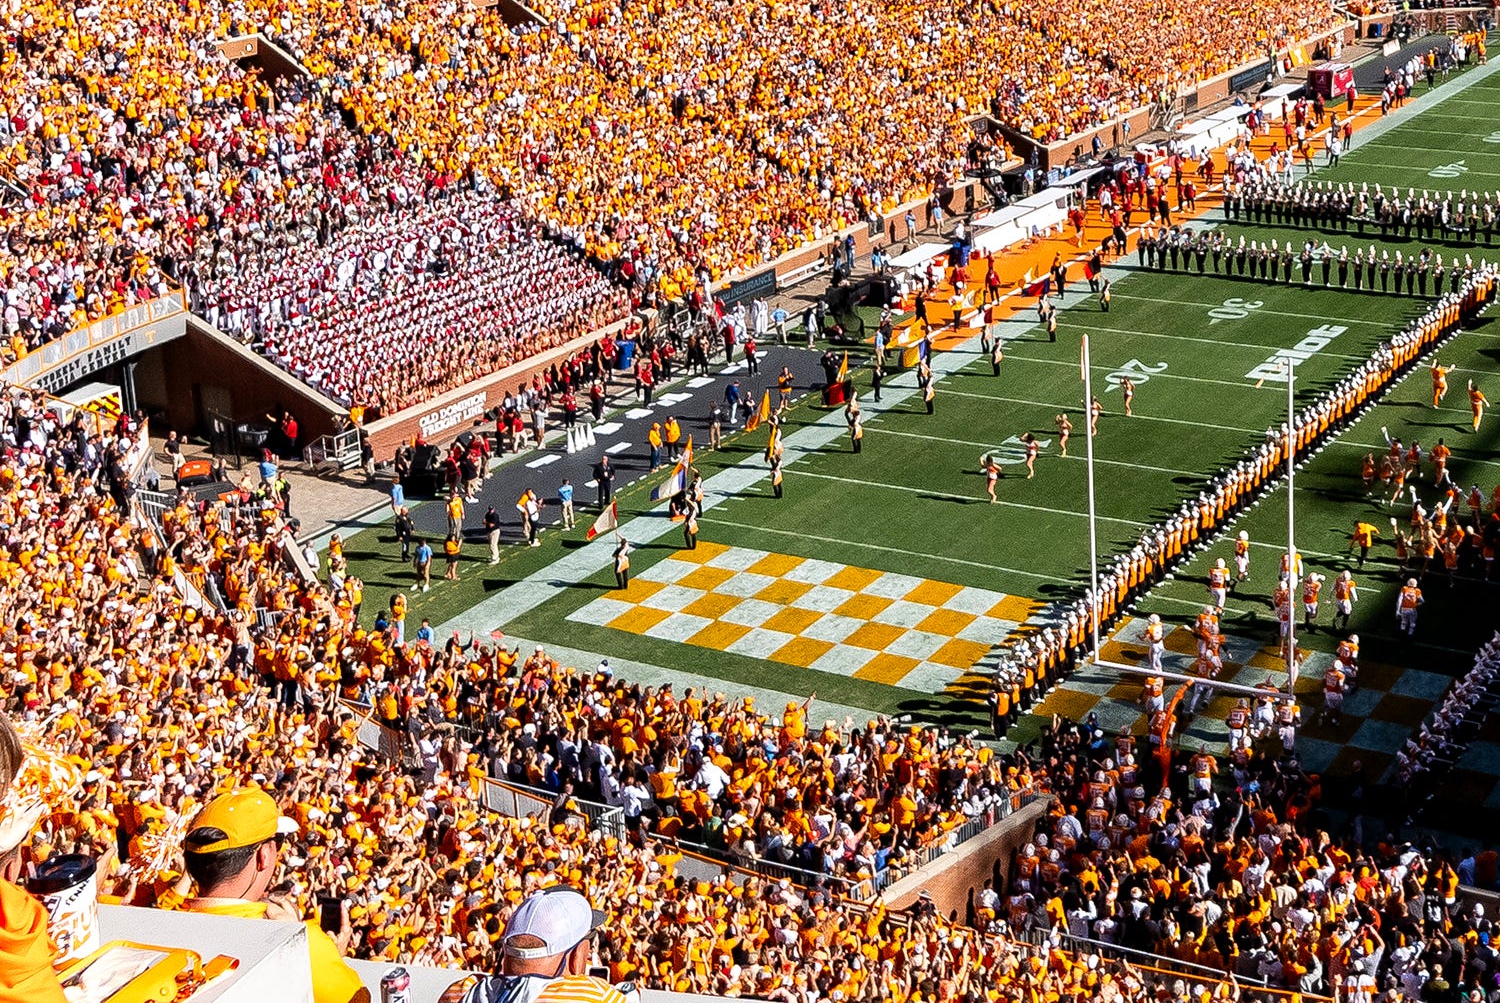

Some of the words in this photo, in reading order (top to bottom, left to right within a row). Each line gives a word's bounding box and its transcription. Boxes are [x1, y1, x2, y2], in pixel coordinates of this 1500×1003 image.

[731, 272, 773, 298] INSURANCE
[1208, 298, 1263, 320] 30
[37, 358, 81, 388] STOKELY
[87, 336, 131, 362] FAMILY
[81, 349, 127, 375] CENTER
[1105, 358, 1168, 386] 20
[419, 411, 439, 427] OLD
[440, 391, 487, 418] DOMINION
[422, 412, 462, 437] FREIGHT
[463, 403, 484, 421] LINE
